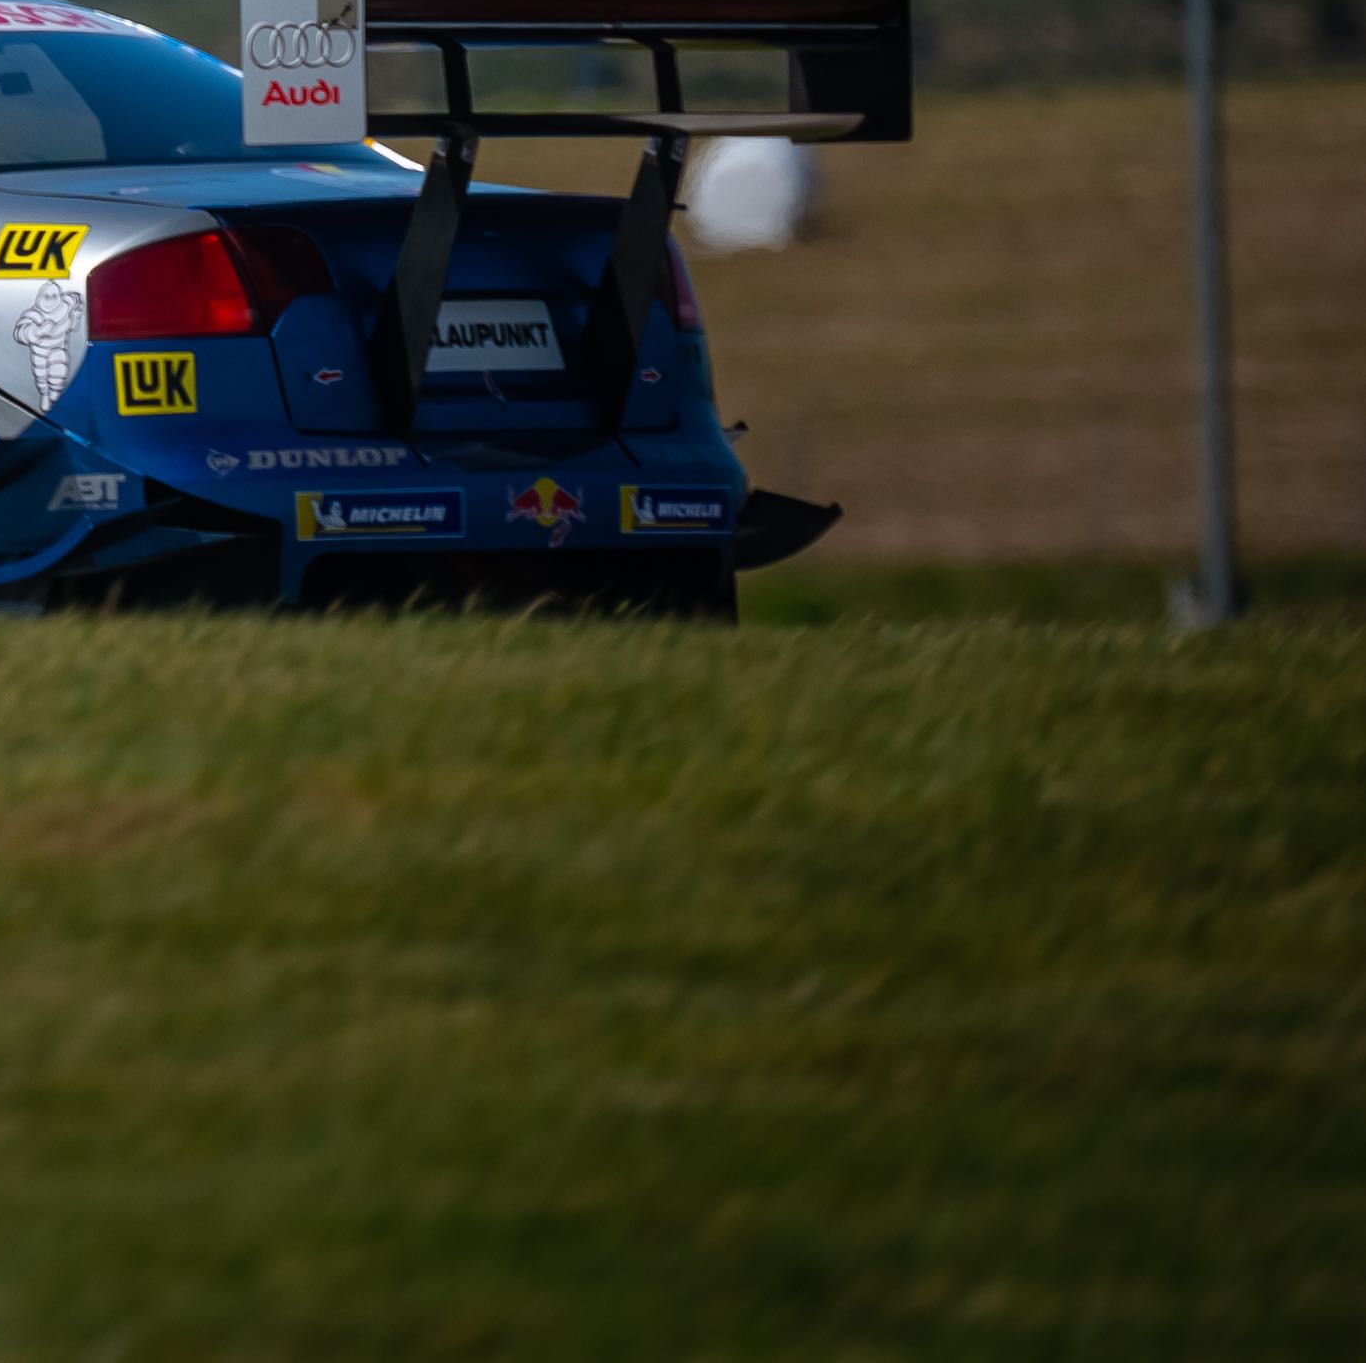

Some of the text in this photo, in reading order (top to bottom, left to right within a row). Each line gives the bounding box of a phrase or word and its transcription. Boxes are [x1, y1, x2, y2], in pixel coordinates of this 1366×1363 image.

[259, 77, 341, 106] Audi
[428, 322, 549, 348] LAUPUNKT
[246, 446, 407, 471] DUNLOP
[46, 473, 126, 512] ABT
[349, 505, 446, 523] MICHELIN
